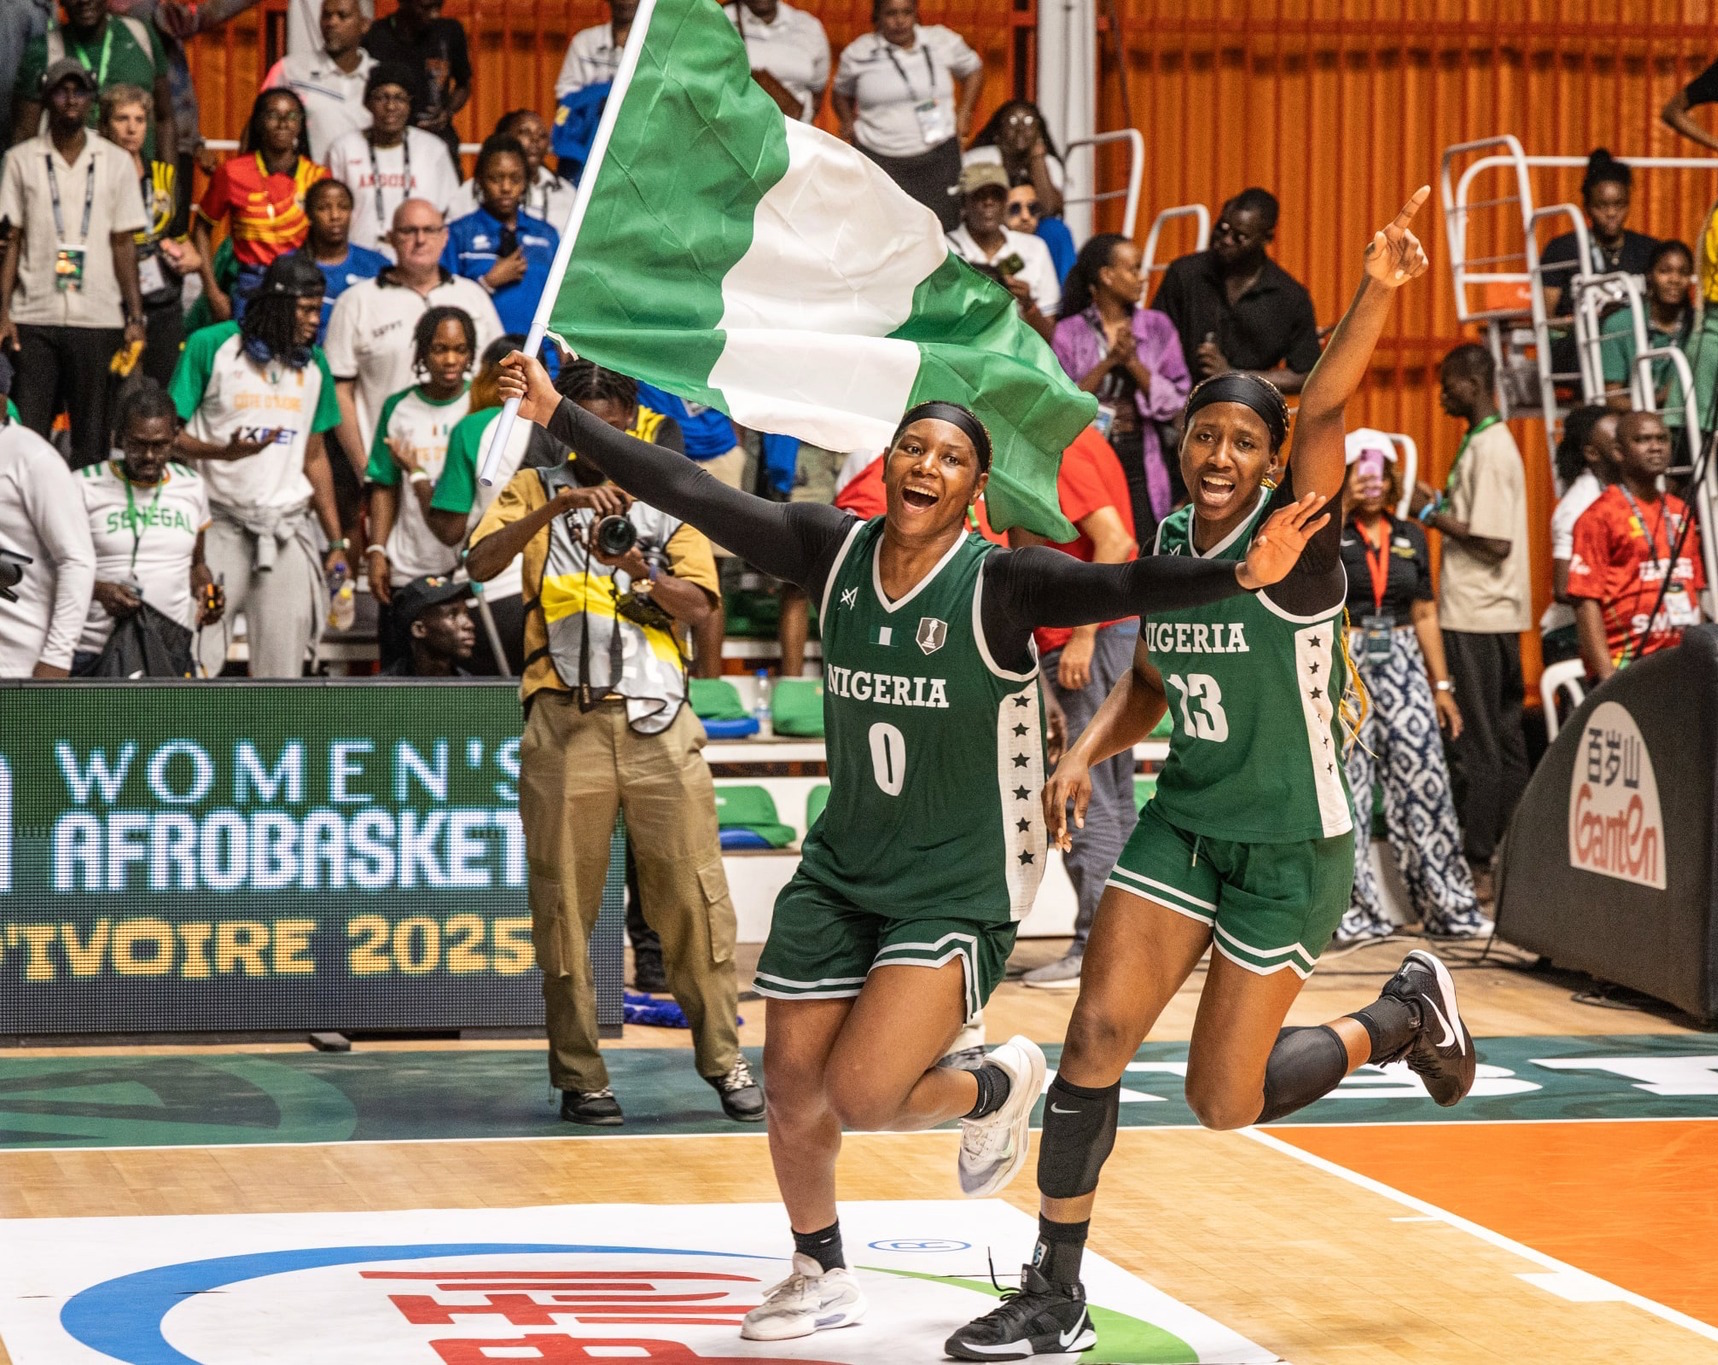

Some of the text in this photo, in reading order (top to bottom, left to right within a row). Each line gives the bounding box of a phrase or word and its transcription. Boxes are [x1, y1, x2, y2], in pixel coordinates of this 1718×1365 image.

[106, 507, 195, 534] SENEGAL
[827, 663, 949, 708] NIGERIA
[1166, 673, 1229, 742] 13
[868, 722, 906, 796] 0
[1588, 728, 1640, 789] 百岁山
[54, 808, 527, 889] AFROBASKET
[1575, 782, 1657, 881] Ganten
[0, 914, 536, 980] 'IVOIRE 2025
